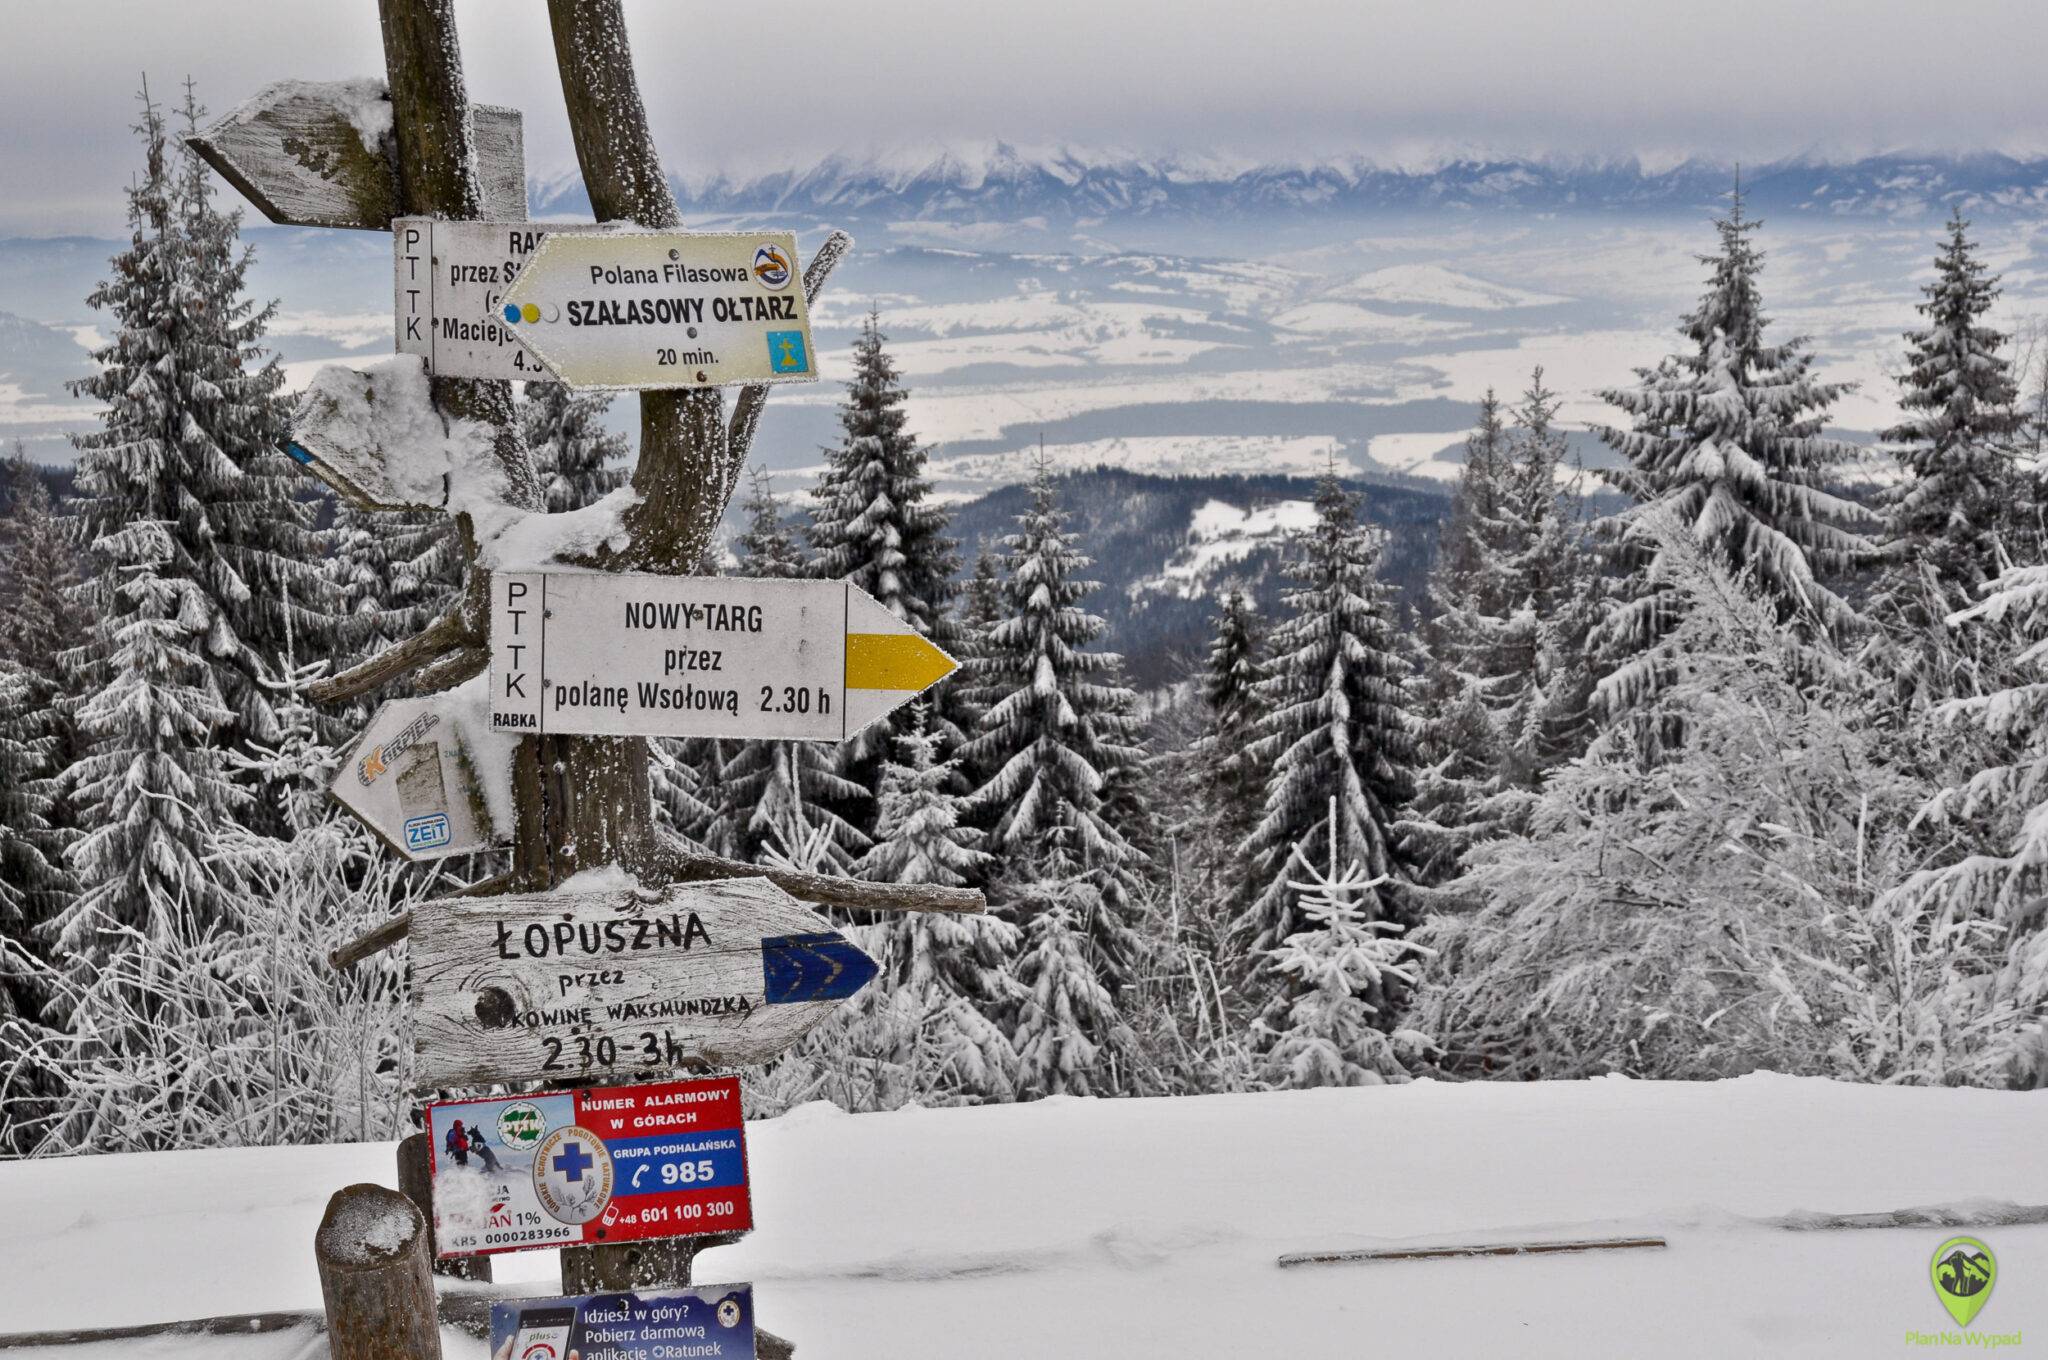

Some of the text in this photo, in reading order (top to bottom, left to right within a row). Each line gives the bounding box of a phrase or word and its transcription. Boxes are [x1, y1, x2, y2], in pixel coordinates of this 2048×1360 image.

[406, 229, 421, 340] PTTK
[451, 261, 521, 286] przez S
[590, 263, 749, 284] Polana Filasowa
[568, 295, 798, 326] SZAŁASOWY OŁTARZ
[656, 347, 719, 366] 20 min.
[625, 602, 762, 632] NOWY TARG
[506, 582, 528, 699] PTTK
[665, 646, 722, 675] przez
[555, 681, 831, 716] polanę Wsołową 2.30 h
[493, 712, 537, 728] RABKA
[493, 912, 712, 959] ŁOPUSZNA
[559, 969, 626, 996] przez
[581, 1089, 730, 1111] NUMER ALARMOWY
[610, 1112, 697, 1129] W GÓRACH
[613, 1139, 736, 1159] GRUPA PODHALAŃSKA
[660, 1160, 715, 1185] 985
[516, 1211, 541, 1226] 1%
[619, 1201, 734, 1224] +48 601 100 300
[485, 1227, 570, 1245] 0000283966
[584, 1305, 689, 1324] Idziesz w góry?
[585, 1325, 706, 1343] Pobierz darmową
[665, 1341, 722, 1358] Ratunek
